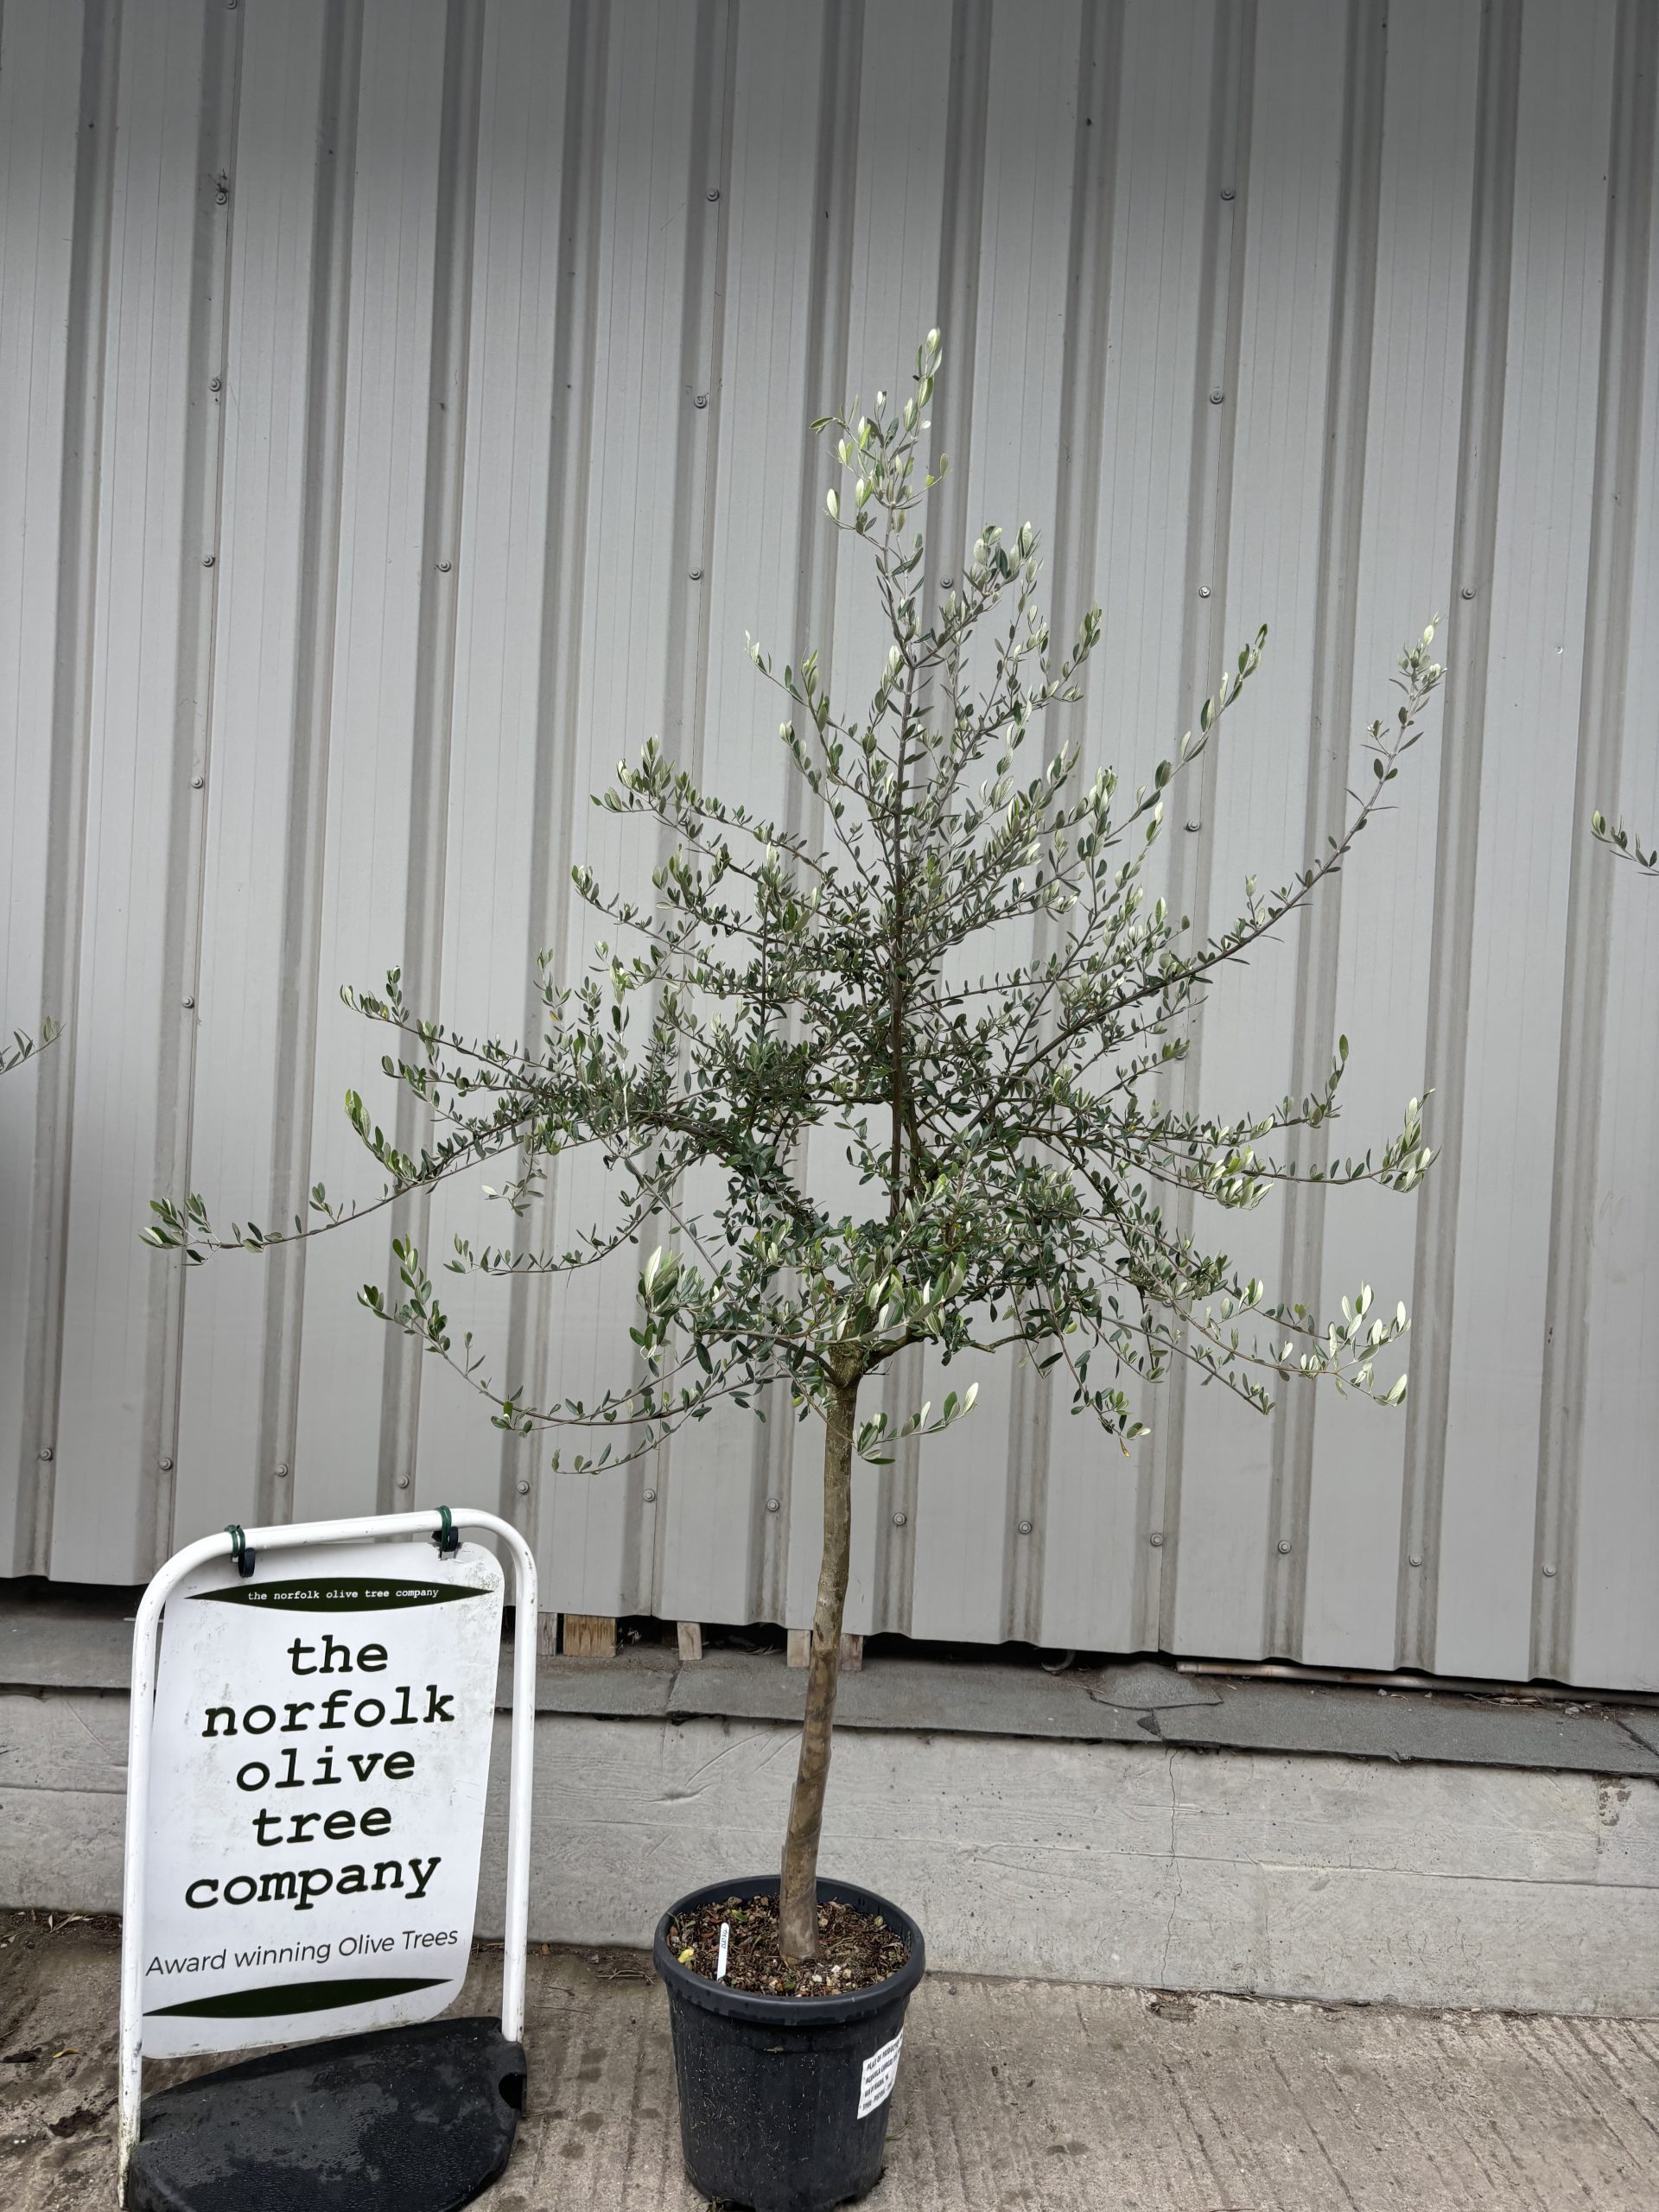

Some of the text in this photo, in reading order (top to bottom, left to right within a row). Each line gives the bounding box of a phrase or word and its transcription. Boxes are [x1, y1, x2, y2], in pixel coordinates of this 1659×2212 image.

[248, 1589, 439, 1600] the norfolk olive tree company
[288, 1634, 388, 1675] the
[201, 1684, 455, 1738] norfolk
[236, 1745, 415, 1792] olive
[251, 1807, 392, 1847] tree
[185, 1856, 442, 1910] company
[145, 1929, 458, 1976] Award winning Olive Trees
